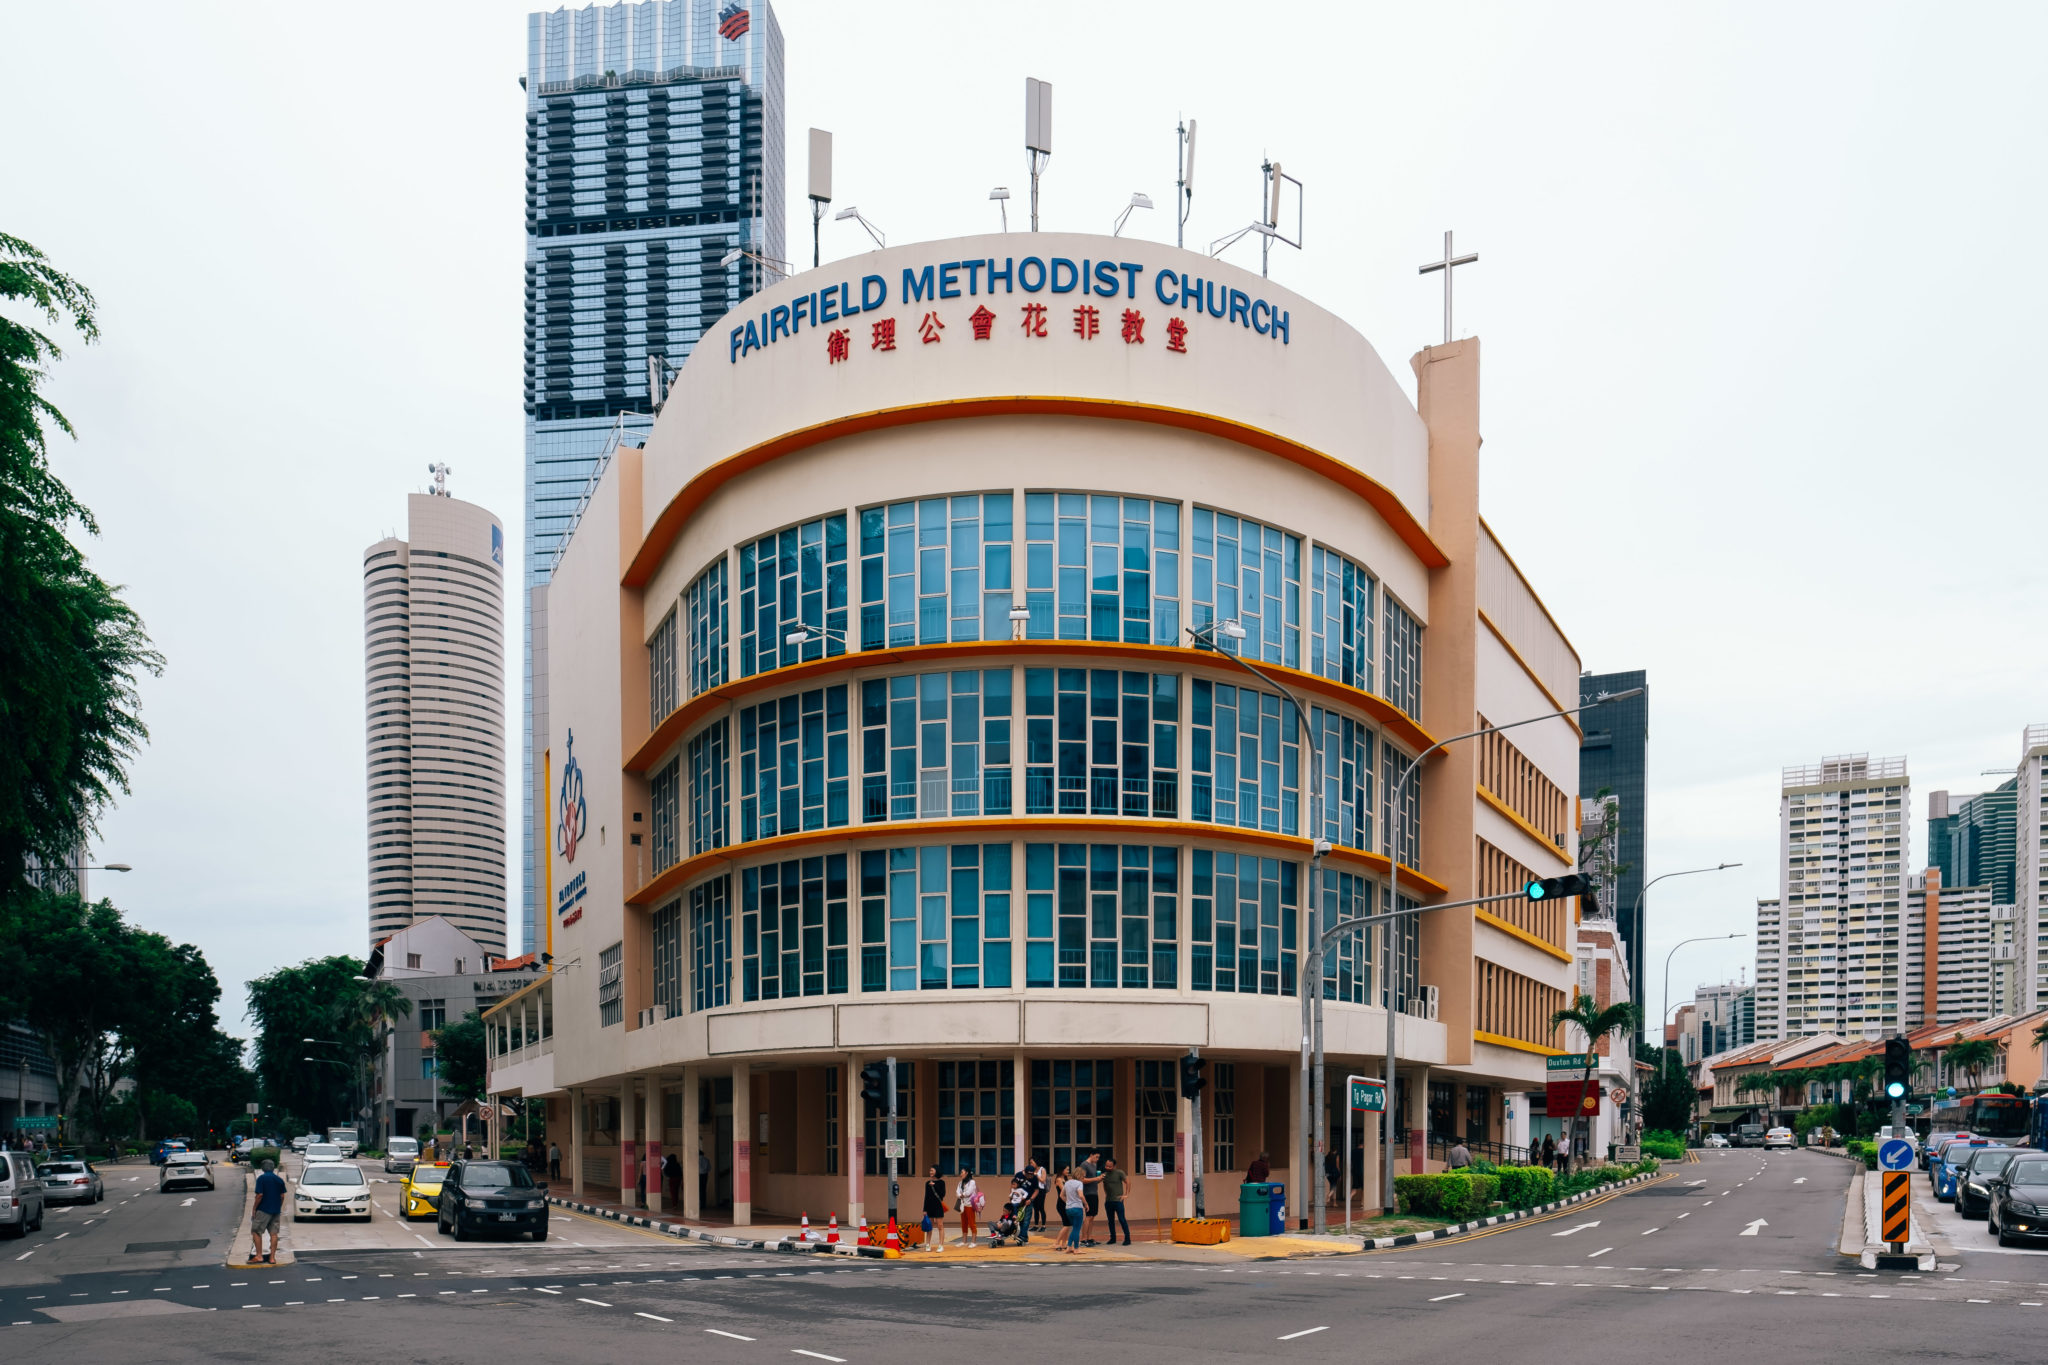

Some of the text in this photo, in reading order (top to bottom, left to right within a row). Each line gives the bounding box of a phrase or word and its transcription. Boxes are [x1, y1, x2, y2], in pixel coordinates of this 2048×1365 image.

[730, 256, 1290, 363] FAIRFIELD METHODIST CHURCH
[1548, 1057, 1581, 1067] Duxton Rd
[1353, 1088, 1382, 1106] Tg Pagar Rd
